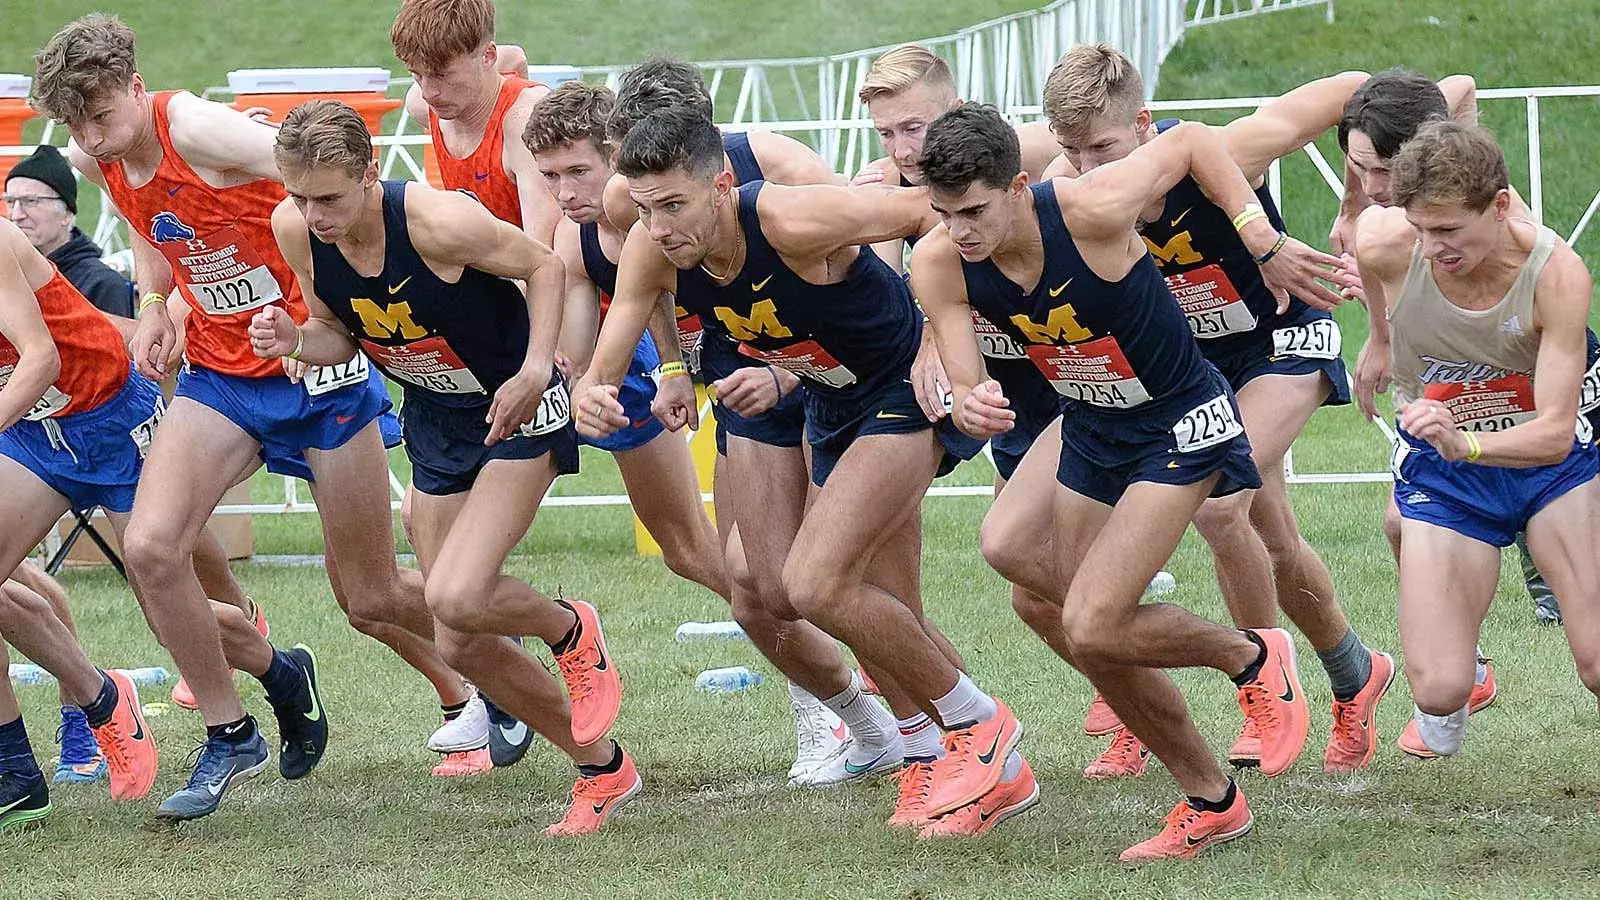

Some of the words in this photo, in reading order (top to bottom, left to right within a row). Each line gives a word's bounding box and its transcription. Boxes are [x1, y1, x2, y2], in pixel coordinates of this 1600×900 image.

[179, 244, 239, 266] NUTTYCOMBE
[189, 256, 237, 274] WISCONSIN
[190, 261, 252, 283] INVITATIONAL
[203, 278, 261, 310] 2122
[350, 298, 428, 339] M
[714, 299, 793, 340] M
[1008, 302, 1094, 344] M
[1187, 309, 1230, 334] 257
[1284, 321, 1331, 352] 2257
[1045, 355, 1113, 366] NUTTYCOMBE
[1068, 382, 1128, 405] 2254
[1182, 399, 1236, 444] 2254
